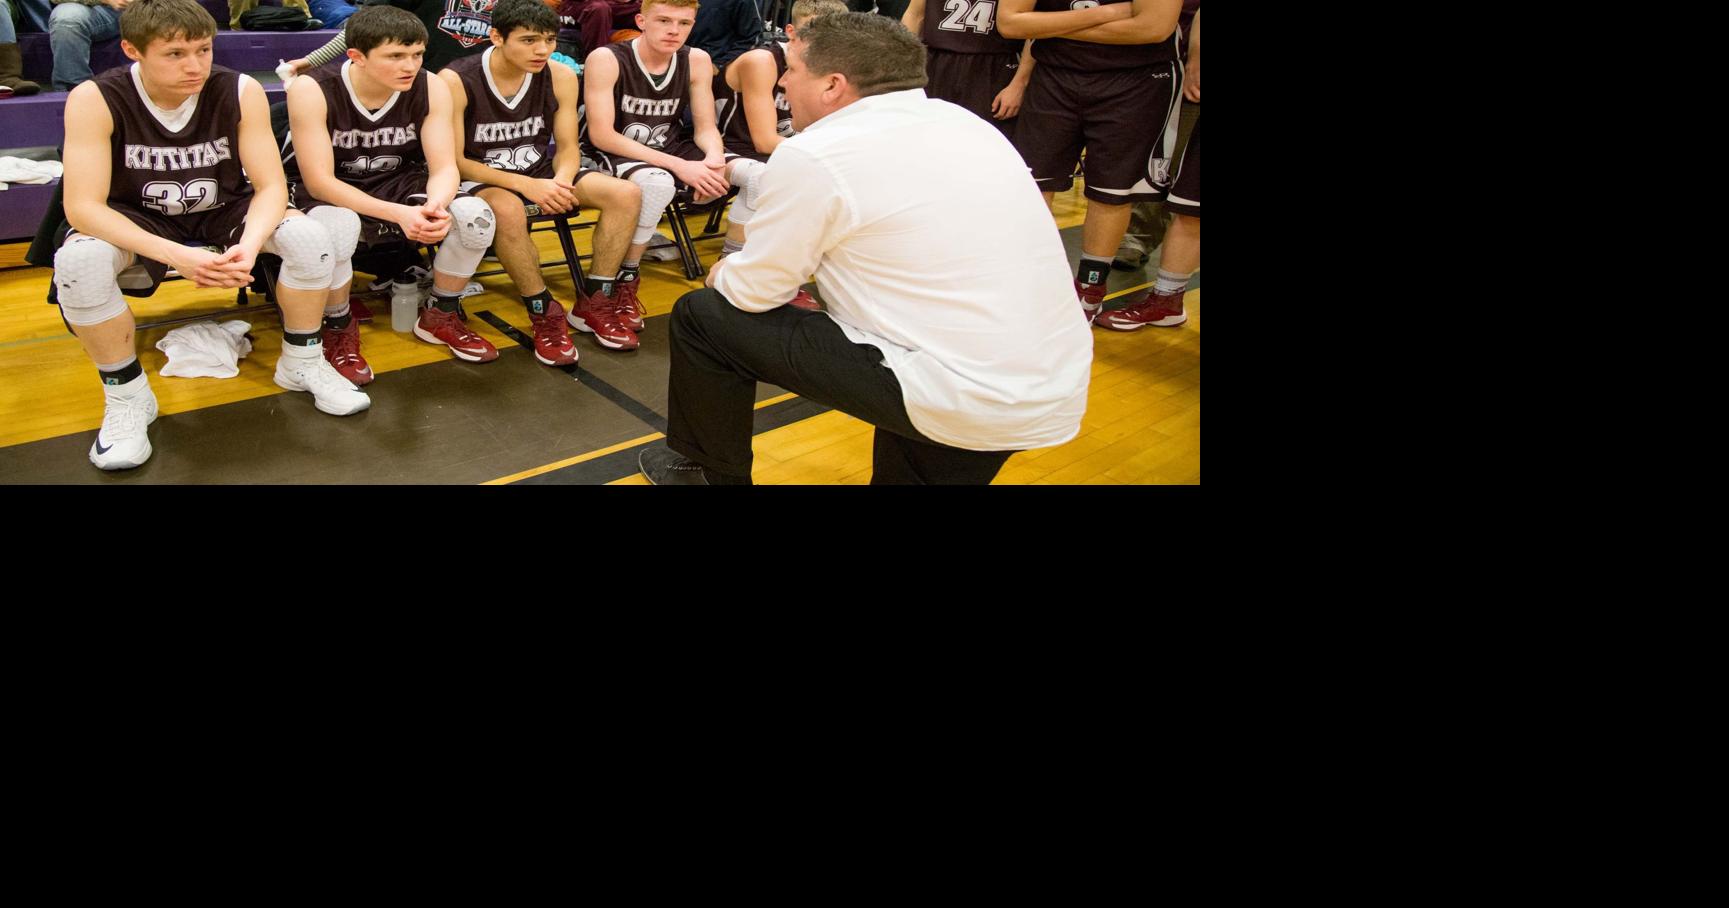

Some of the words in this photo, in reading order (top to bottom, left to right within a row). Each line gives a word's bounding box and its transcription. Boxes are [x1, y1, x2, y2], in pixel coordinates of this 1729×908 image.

[938, 0, 995, 35] 24
[333, 123, 417, 149] KITTITAS
[474, 115, 545, 142] KITTITA
[125, 137, 232, 171] KITTITAS
[142, 178, 225, 216] 32
